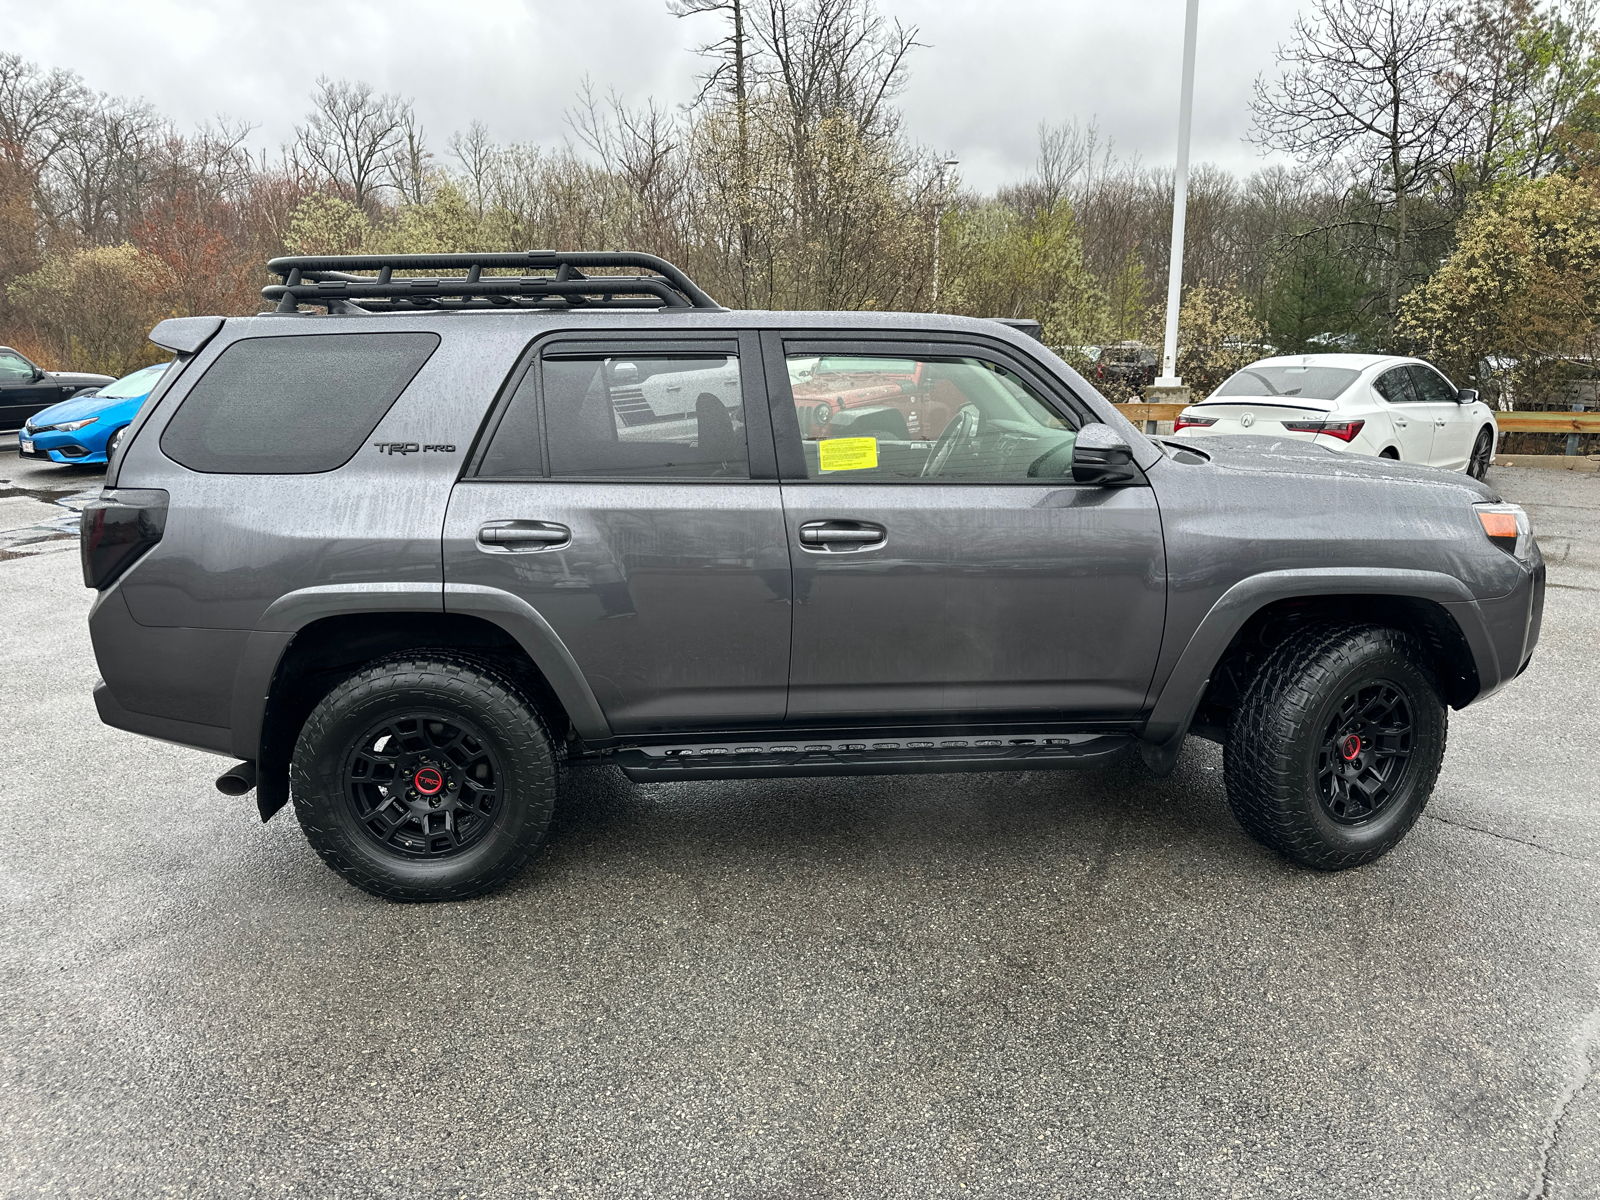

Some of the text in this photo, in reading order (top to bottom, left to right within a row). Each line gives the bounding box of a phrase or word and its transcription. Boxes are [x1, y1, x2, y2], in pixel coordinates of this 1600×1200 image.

[374, 442, 456, 455] TRD PRO
[419, 775, 440, 786] TRD
